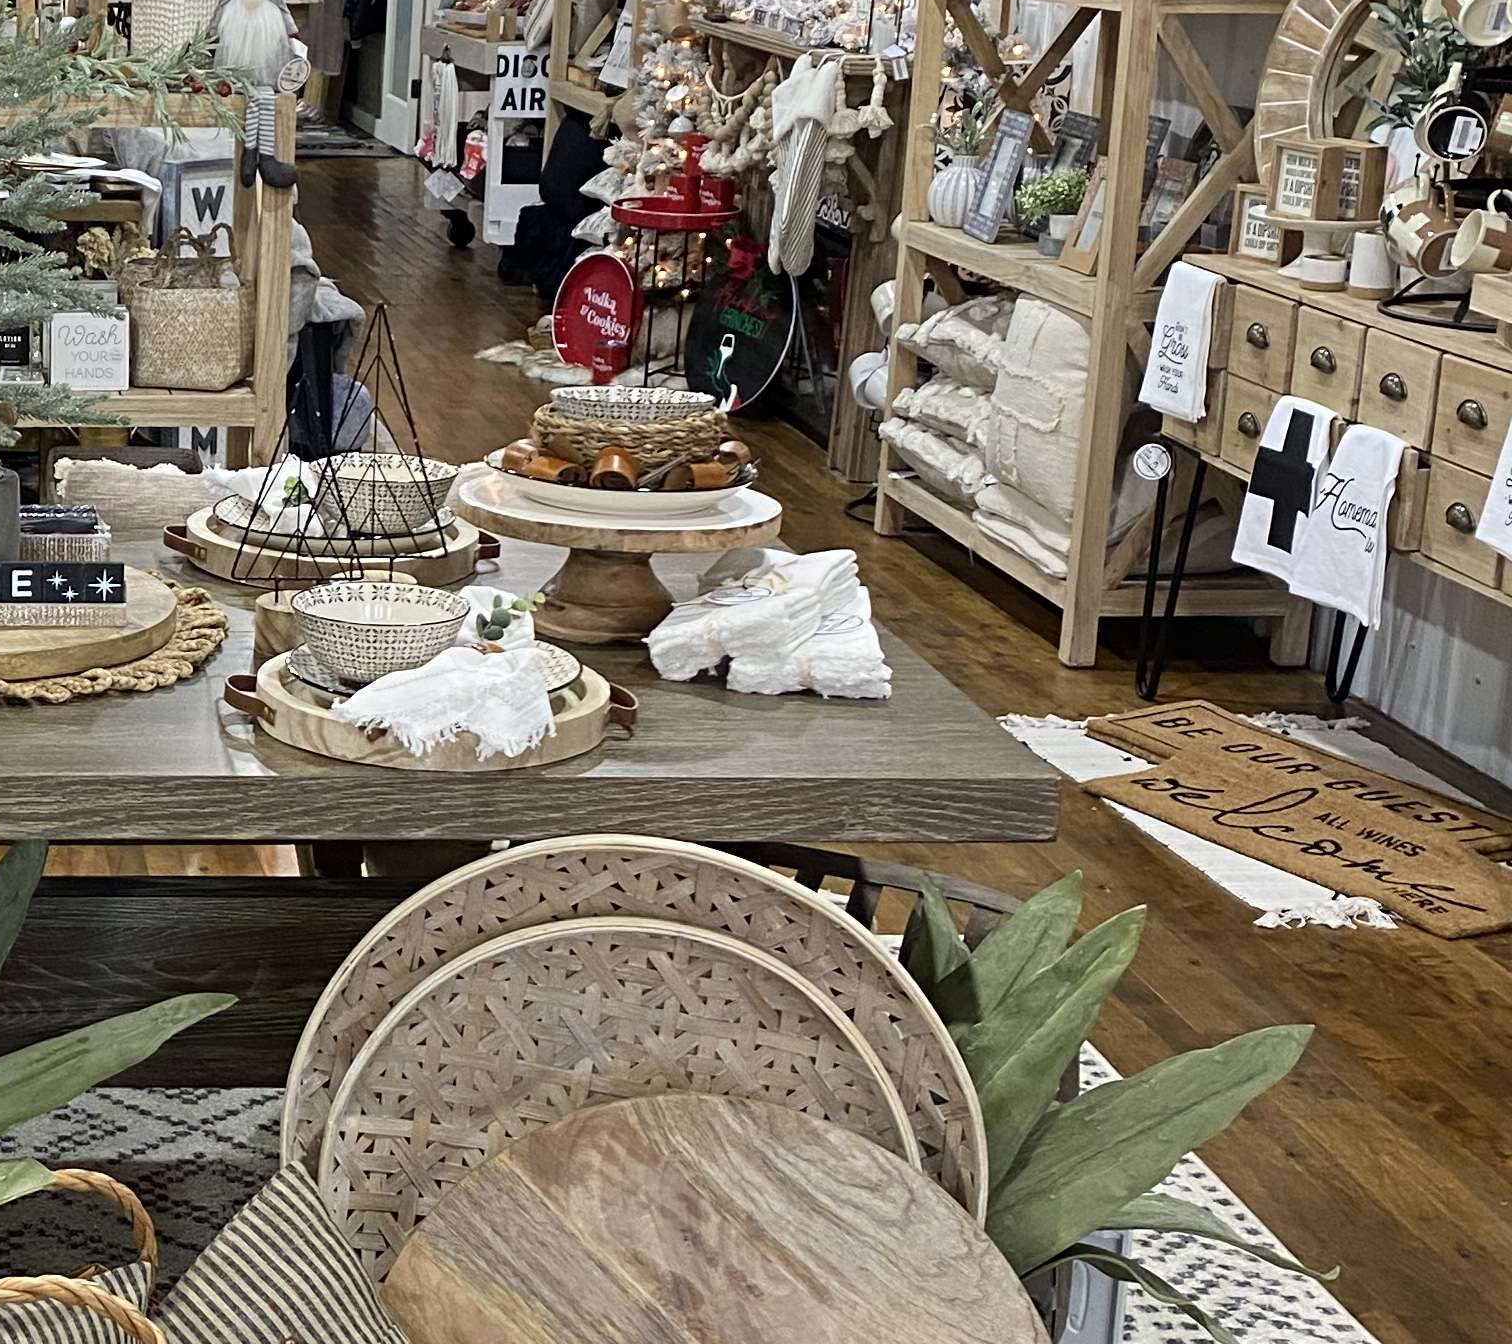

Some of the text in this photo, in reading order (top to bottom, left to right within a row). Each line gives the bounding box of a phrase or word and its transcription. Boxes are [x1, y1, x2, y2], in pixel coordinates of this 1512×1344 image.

[583, 286, 617, 316] Vodka
[58, 323, 123, 347] Wash
[586, 311, 627, 338] Cookies
[70, 350, 109, 362] YOUR
[64, 366, 115, 380] HANDS
[1314, 472, 1378, 532] Homema
[1151, 716, 1494, 843] BE OUR GUEST
[1130, 777, 1488, 913] welcome
[1312, 811, 1428, 858] ALL WINES
